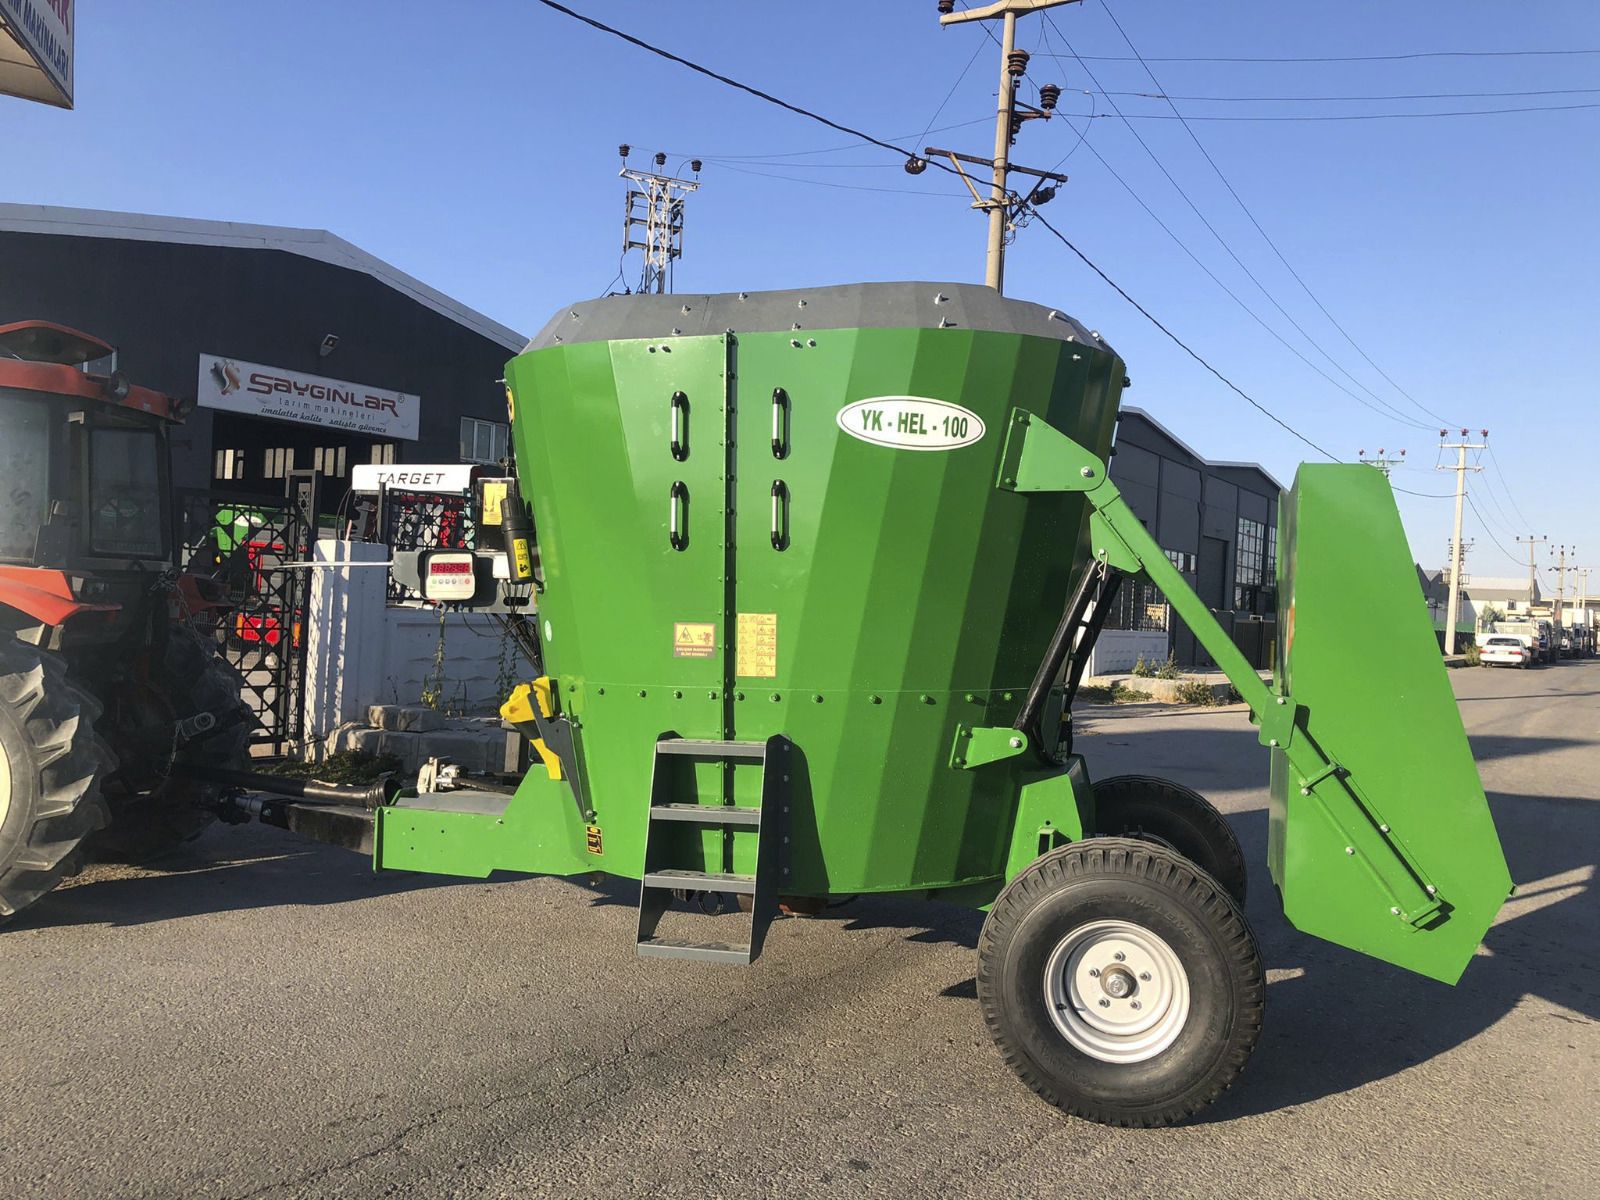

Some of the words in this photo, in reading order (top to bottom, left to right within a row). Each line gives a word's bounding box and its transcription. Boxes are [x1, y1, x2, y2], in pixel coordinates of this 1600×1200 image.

[261, 405, 299, 418] imalatta
[300, 412, 322, 422] kalite
[358, 423, 387, 433] güvence
[314, 404, 375, 420] makineleri
[861, 409, 884, 431] YK
[897, 412, 928, 435] HEL
[942, 415, 968, 438] 100
[377, 472, 446, 484] TARGET
